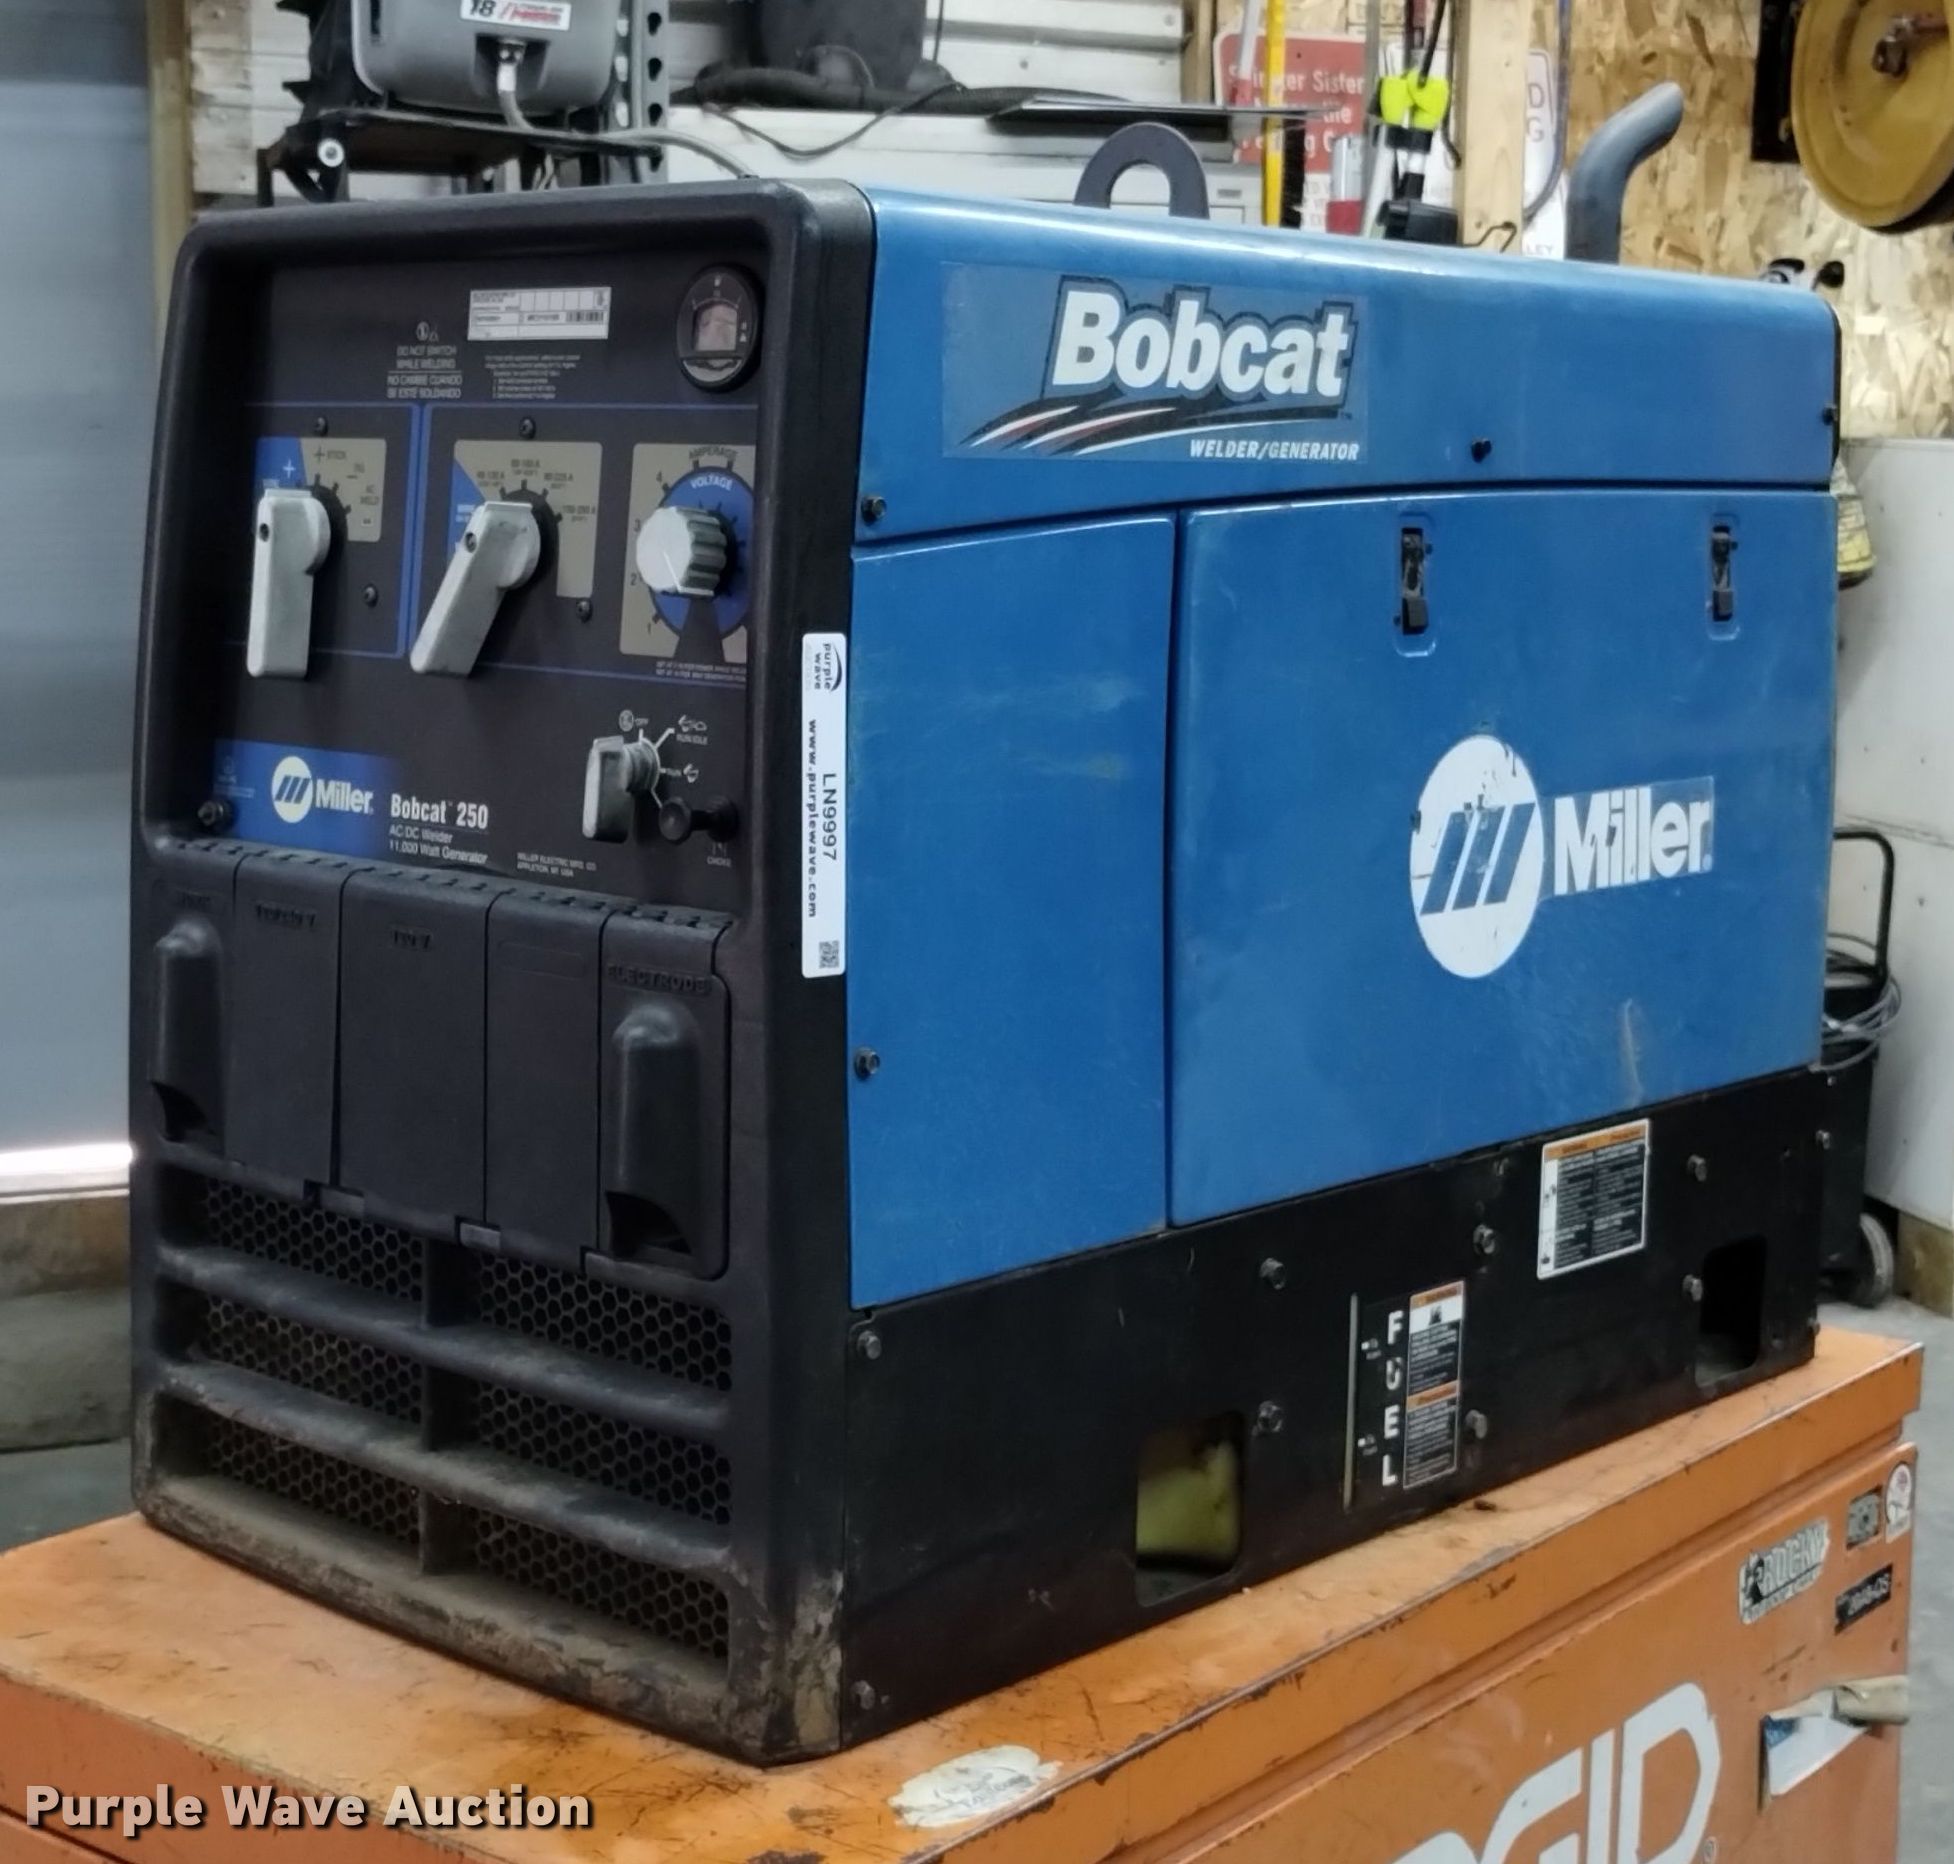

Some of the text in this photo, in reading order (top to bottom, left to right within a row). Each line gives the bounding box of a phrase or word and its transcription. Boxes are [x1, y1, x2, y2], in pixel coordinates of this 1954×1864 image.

[1313, 70, 1364, 94] Sister
[1052, 290, 1349, 398] Bobcat
[1190, 438, 1360, 461] WELDER/GENERATOR
[690, 473, 734, 491] VOLTAGE
[630, 572, 638, 586] 2
[813, 652, 823, 690] wave
[822, 643, 833, 691] purple
[315, 779, 373, 815] Miller
[390, 793, 489, 829] Bobcat 250
[807, 719, 818, 918] www.purplewave.com
[823, 773, 837, 861] LN9997
[1554, 785, 1711, 896] Miller
